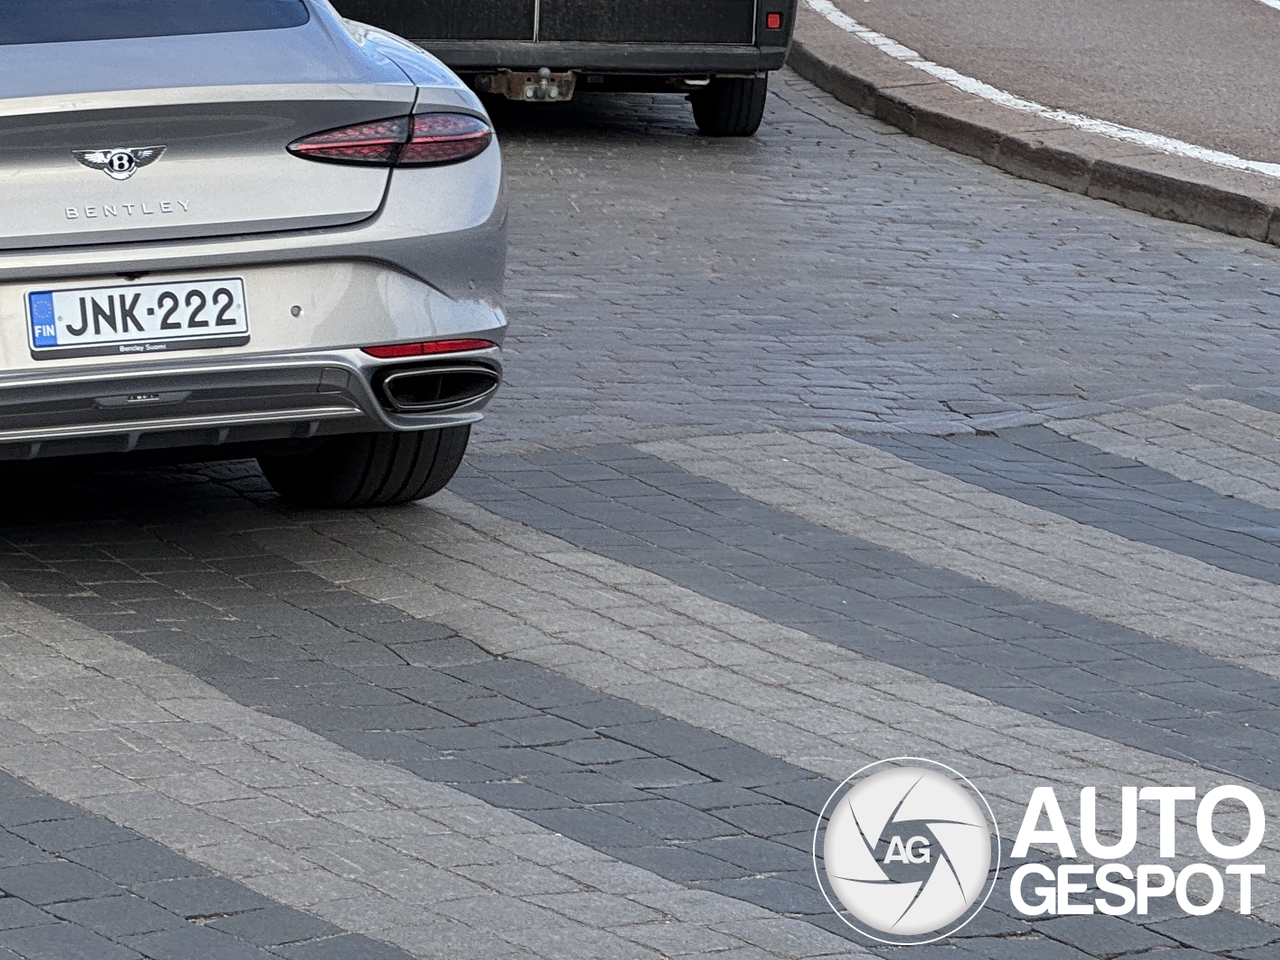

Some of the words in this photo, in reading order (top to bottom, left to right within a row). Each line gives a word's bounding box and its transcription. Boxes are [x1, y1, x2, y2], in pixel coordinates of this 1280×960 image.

[65, 199, 191, 220] BENTLEY
[66, 288, 237, 336] JNK-222
[34, 324, 55, 338] FIN
[119, 344, 144, 353] Bentley
[145, 343, 167, 351] Suomi
